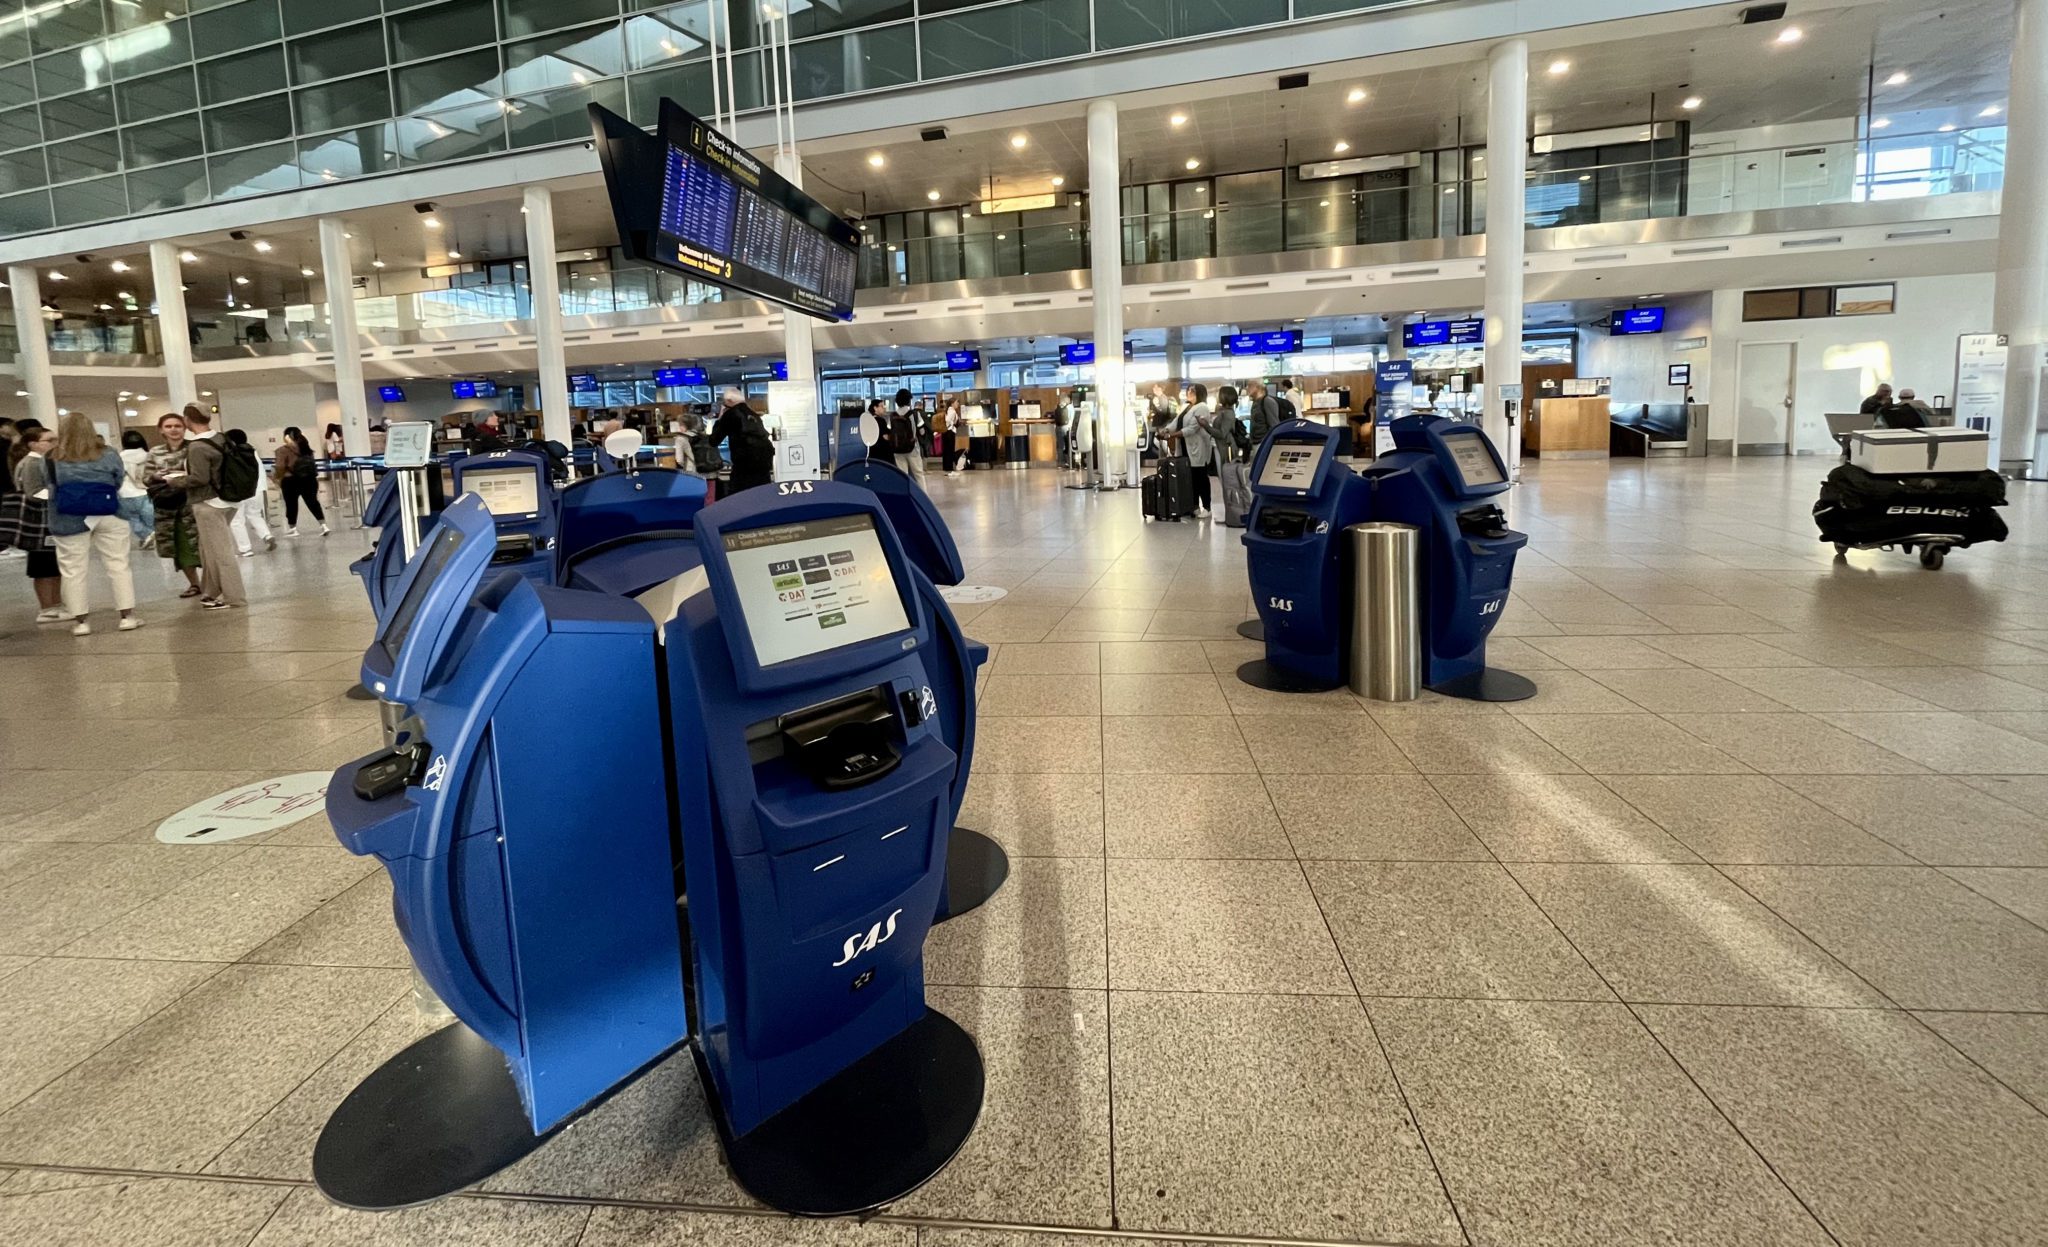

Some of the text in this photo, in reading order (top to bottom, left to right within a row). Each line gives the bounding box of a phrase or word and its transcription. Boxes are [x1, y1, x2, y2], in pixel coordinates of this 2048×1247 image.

[707, 130, 761, 175] Check-in information
[724, 262, 732, 278] 3
[778, 480, 814, 496] SAS
[775, 563, 790, 572] SAS
[841, 566, 857, 576] DAT
[788, 589, 805, 600] DAT
[1269, 596, 1294, 612] SAS
[1478, 599, 1501, 615] SAS
[832, 908, 903, 967] SAS
